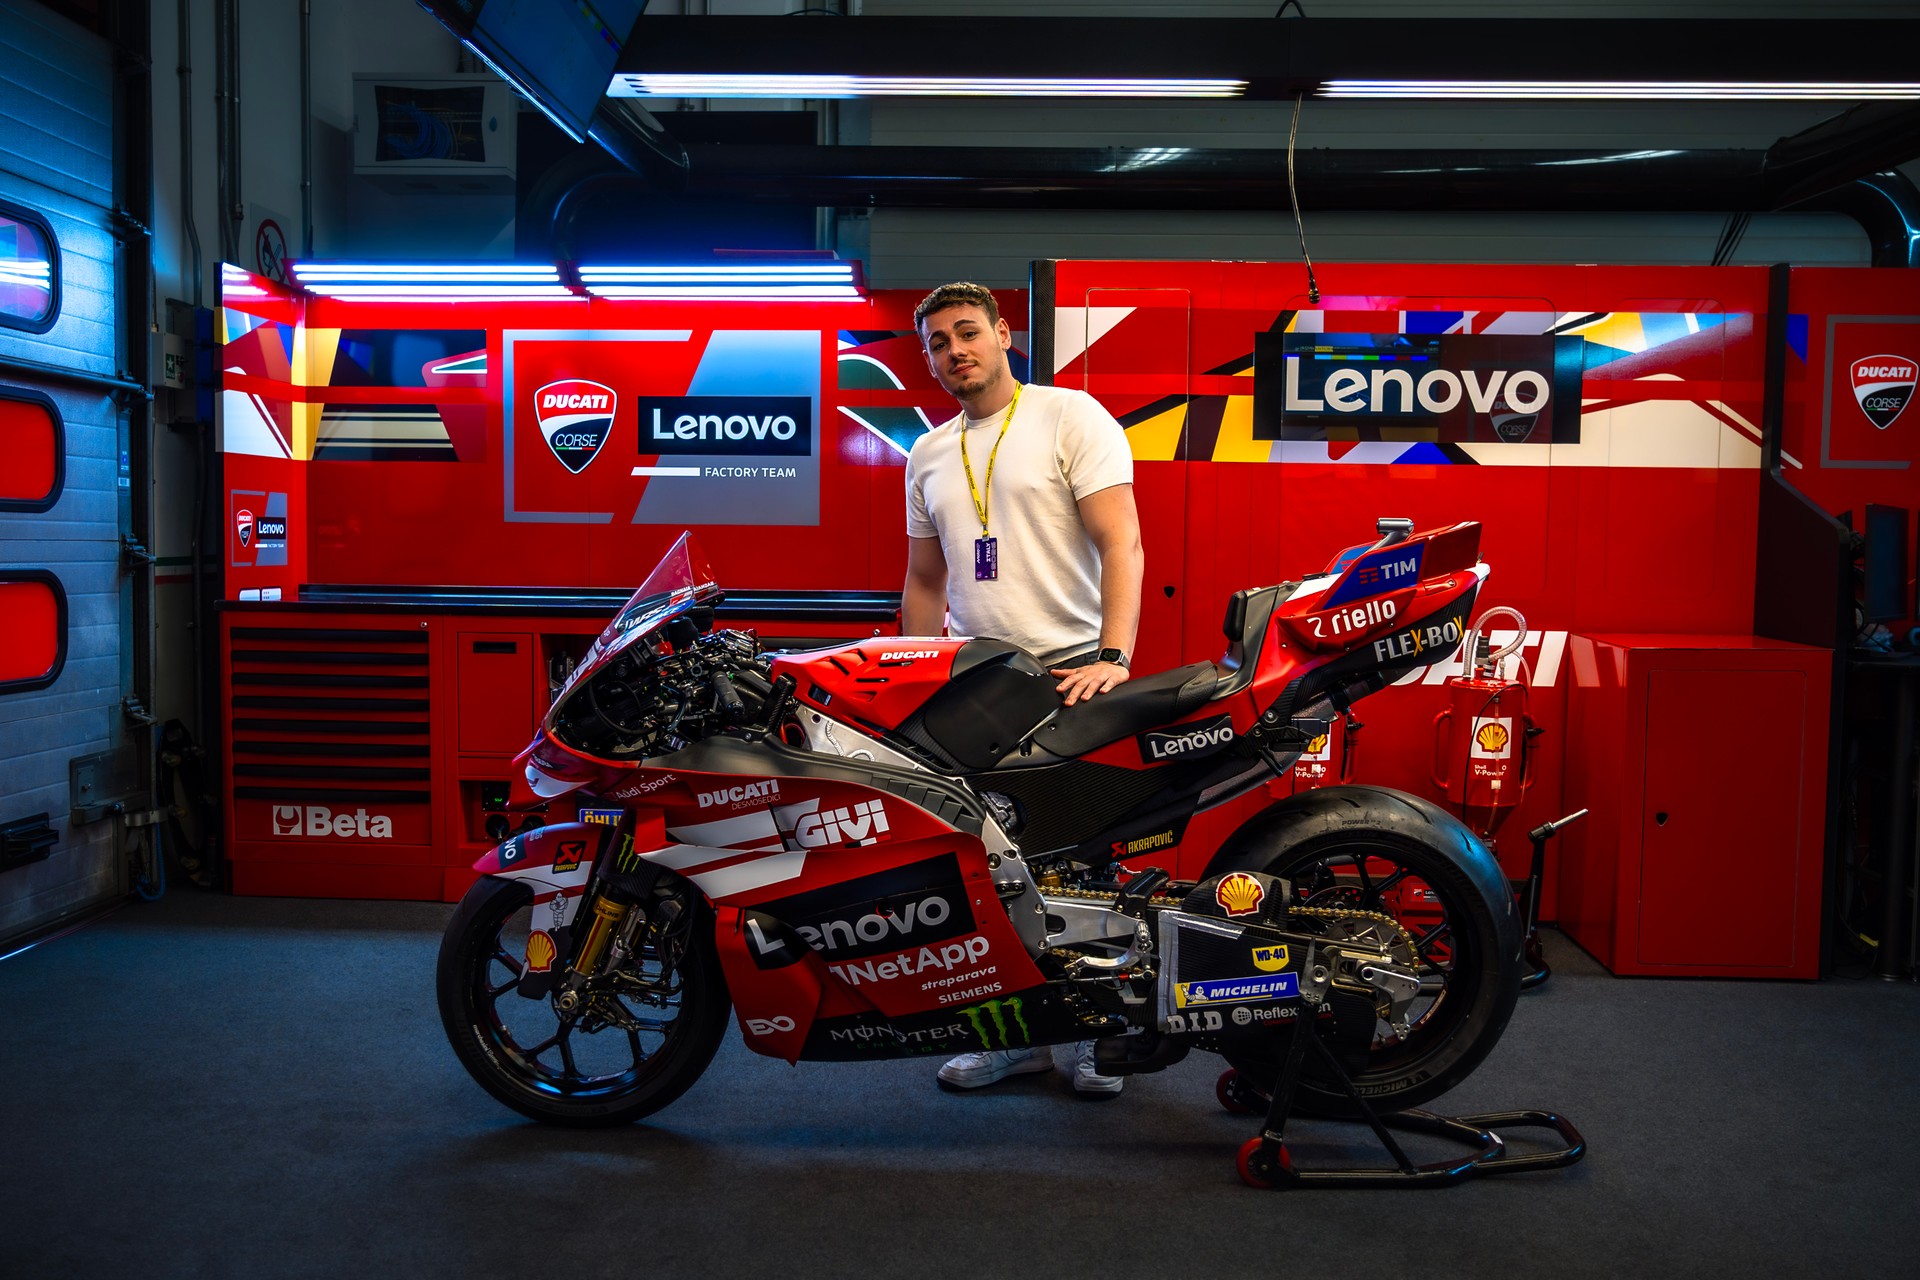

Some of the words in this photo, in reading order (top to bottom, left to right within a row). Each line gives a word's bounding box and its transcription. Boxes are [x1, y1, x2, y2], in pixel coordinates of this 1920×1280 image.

[1285, 356, 1550, 414] Lenovo
[1857, 366, 1912, 378] DUCATI
[543, 394, 608, 409] DUCATI
[1865, 397, 1902, 408] CORSE
[652, 408, 797, 441] Lenovo
[555, 433, 597, 447] CORSE
[705, 467, 759, 478] FACTORY
[761, 467, 797, 478] TEAM
[258, 520, 285, 535] Lenovo
[1380, 557, 1416, 580] TIM
[1331, 600, 1396, 635] riello
[1373, 616, 1464, 662] FLEX-BOX
[880, 650, 940, 661] DUCATI
[1150, 727, 1234, 759] Lenovo
[615, 786, 641, 801] Audi
[641, 773, 677, 793] Sport
[697, 779, 780, 809] DUCATI
[731, 793, 781, 811] DESMOSEDICI
[306, 805, 393, 838] Beta
[795, 798, 891, 848] GIVI
[746, 896, 951, 956] Lenovo
[844, 936, 991, 986] NetApp
[920, 965, 998, 991] streparava
[1209, 981, 1288, 998] MICHELIN
[937, 981, 1004, 1004] SIEMENS
